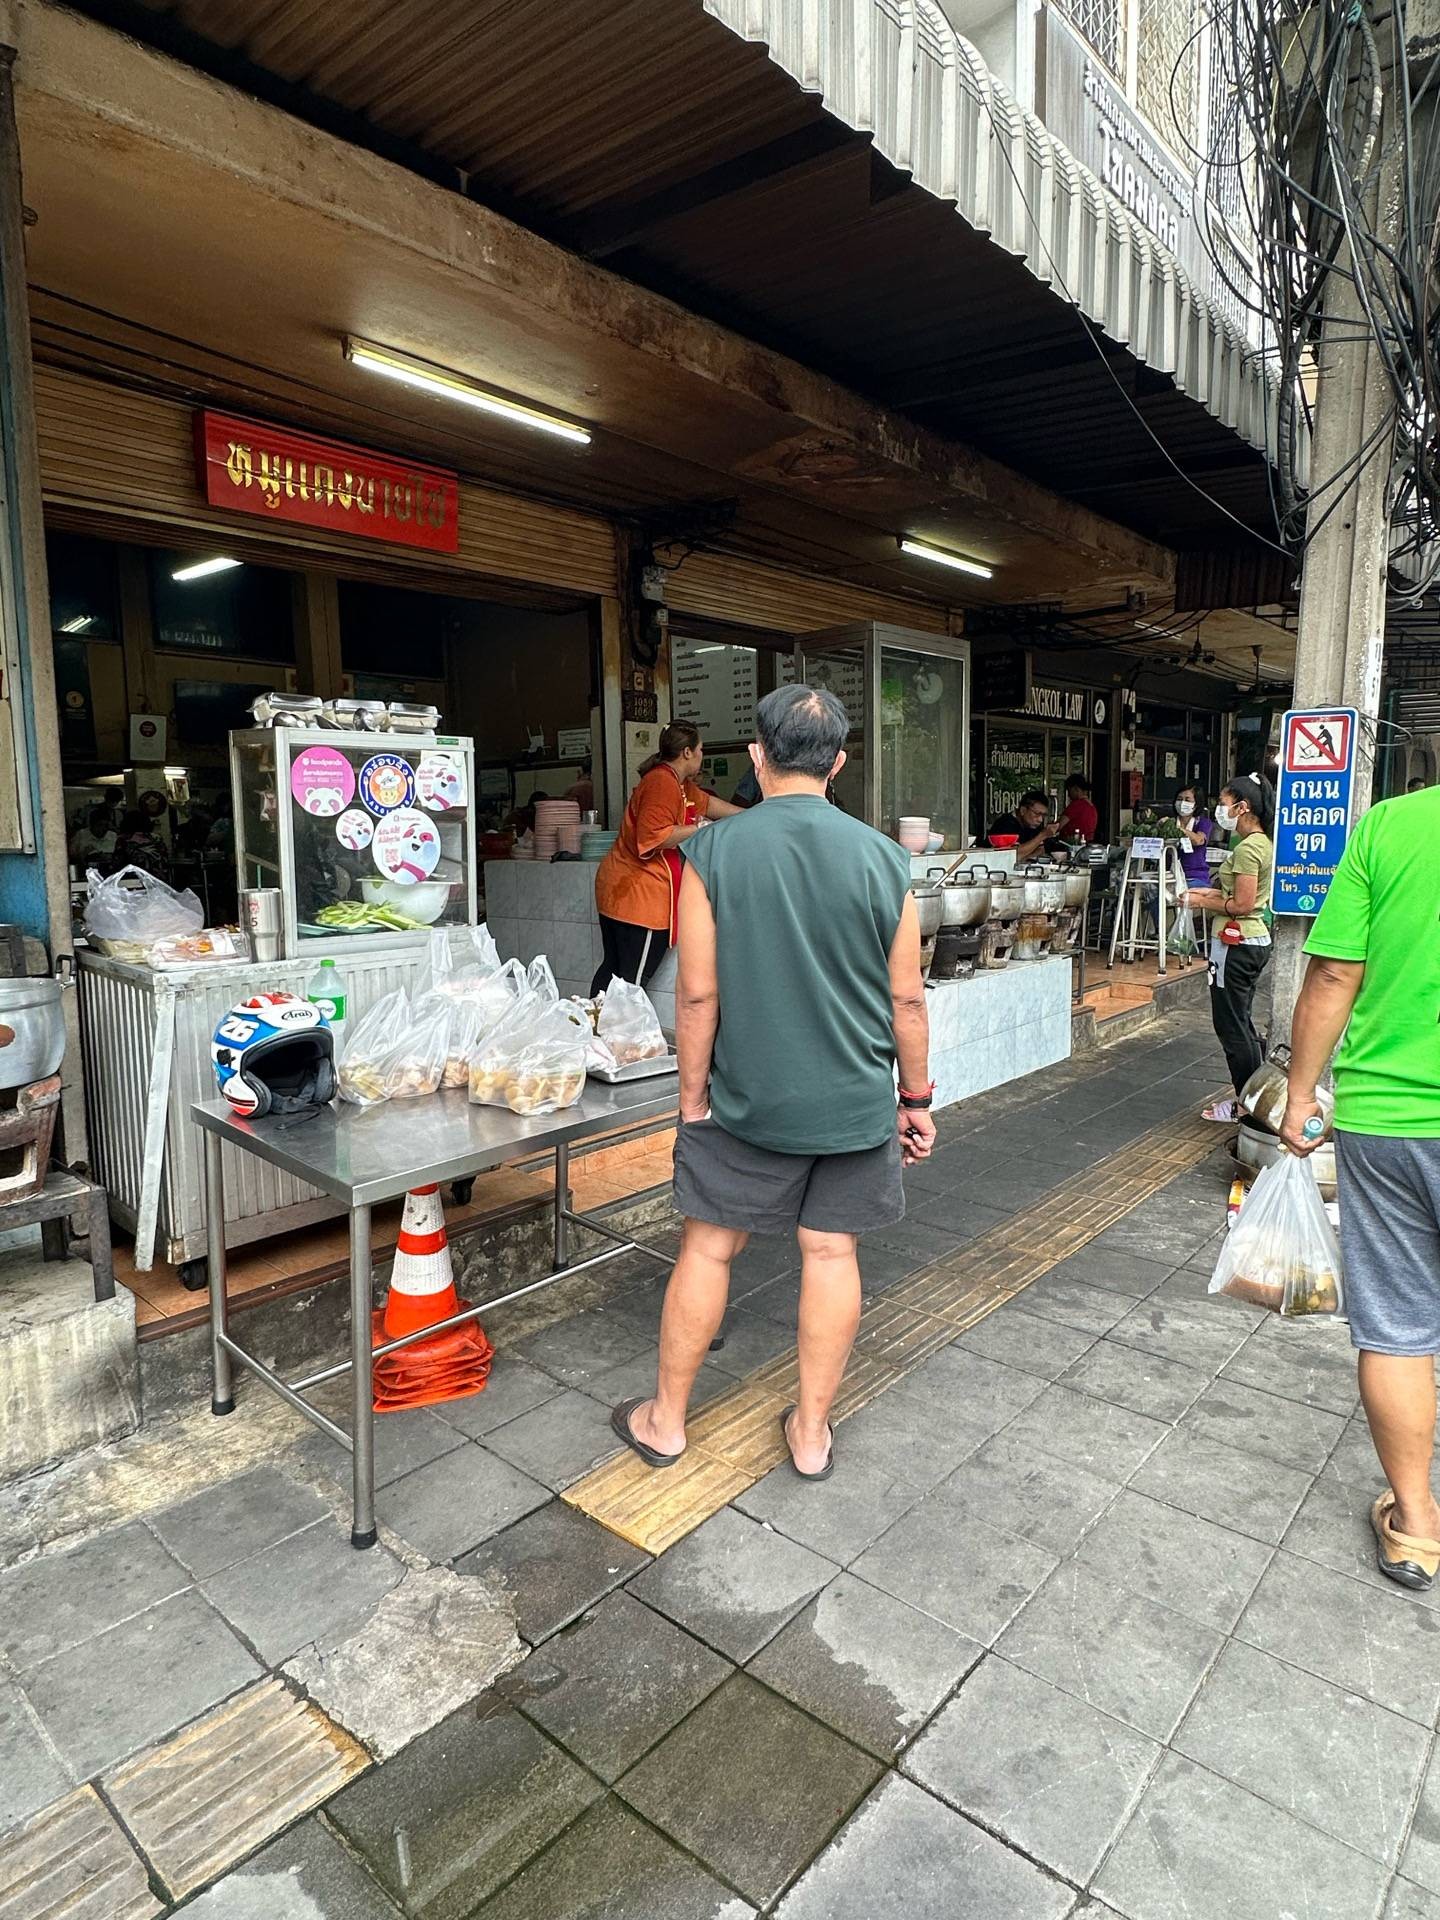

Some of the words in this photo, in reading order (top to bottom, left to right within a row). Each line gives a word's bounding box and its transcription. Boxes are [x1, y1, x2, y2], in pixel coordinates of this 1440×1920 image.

[1065, 692, 1084, 720] LAW
[1291, 780, 1340, 799] ถนน
[1281, 803, 1345, 825] ปลอด
[1294, 833, 1327, 859] ขุด
[1308, 884, 1329, 894] 155
[286, 1010, 309, 1019] Arai
[219, 1015, 260, 1043] 26
